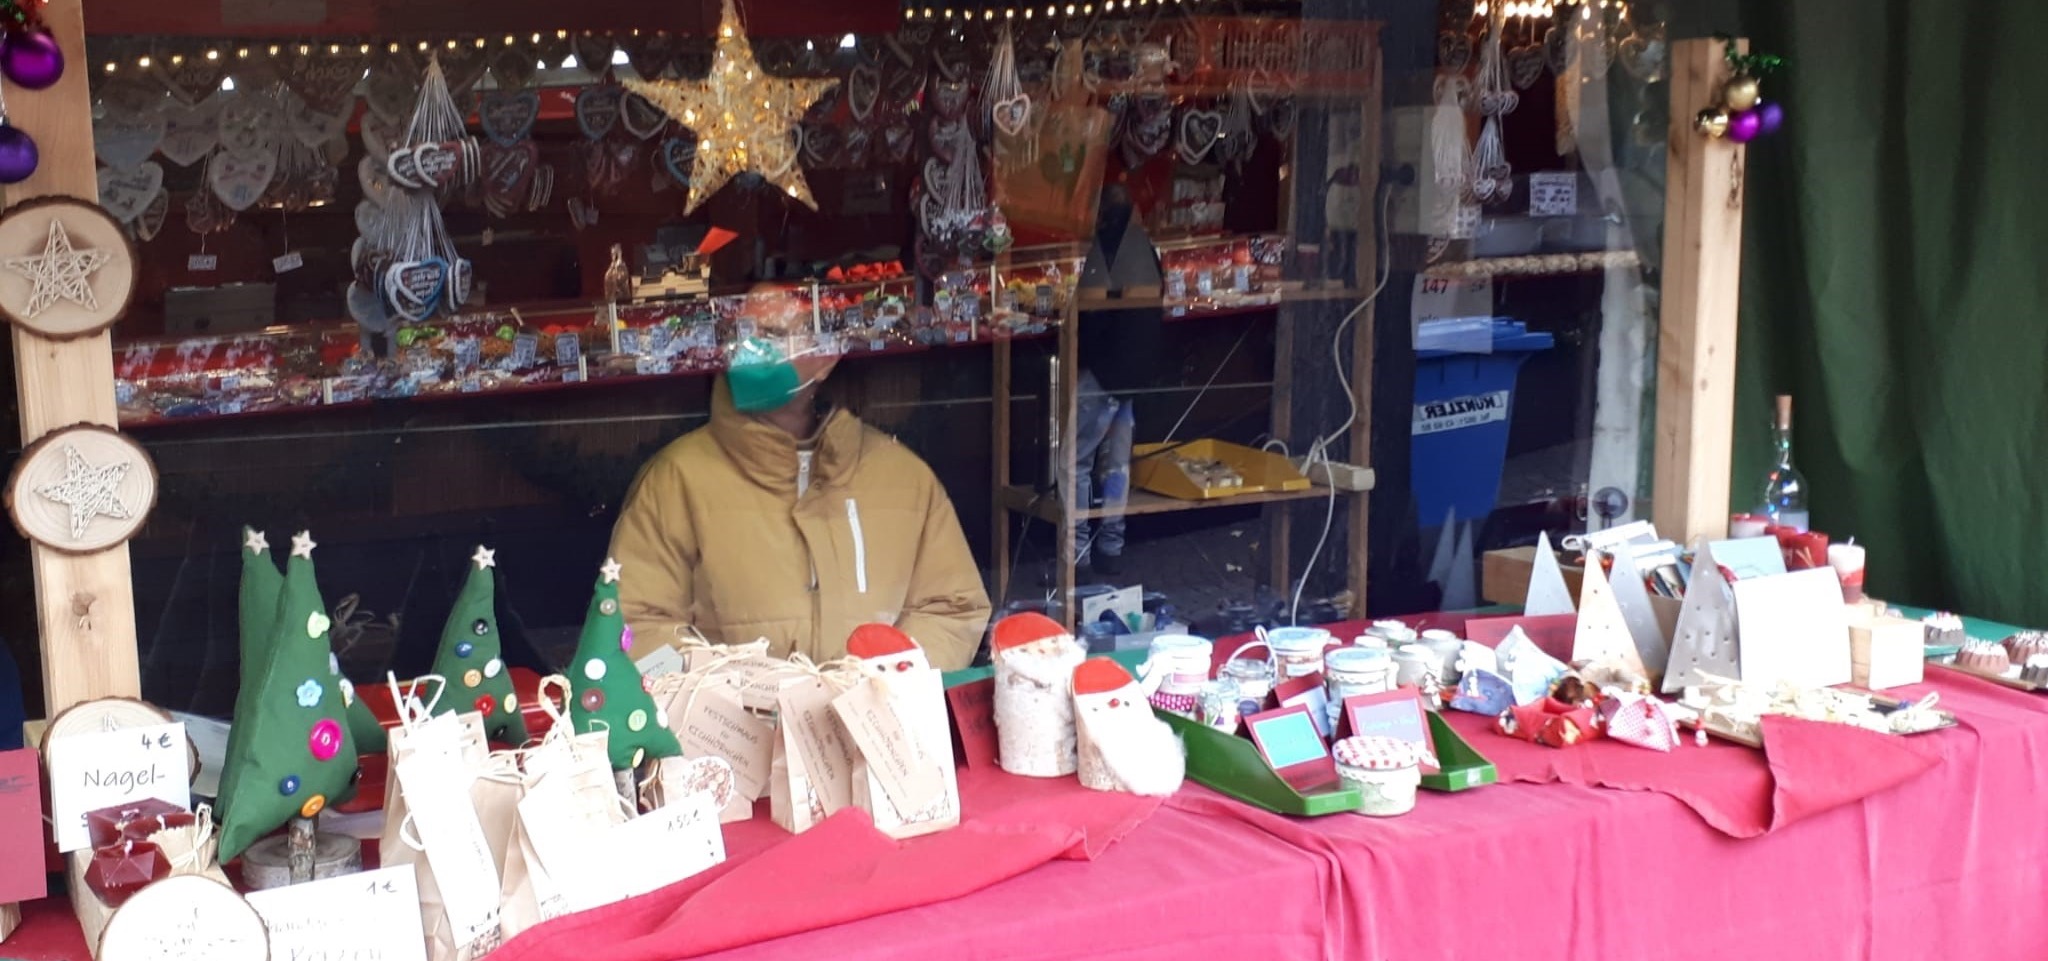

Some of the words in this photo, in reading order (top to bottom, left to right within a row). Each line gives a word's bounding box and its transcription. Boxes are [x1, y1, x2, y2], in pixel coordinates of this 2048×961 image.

[1421, 279, 1448, 295] 147
[141, 733, 152, 749] 4
[84, 763, 166, 795] Nagel-
